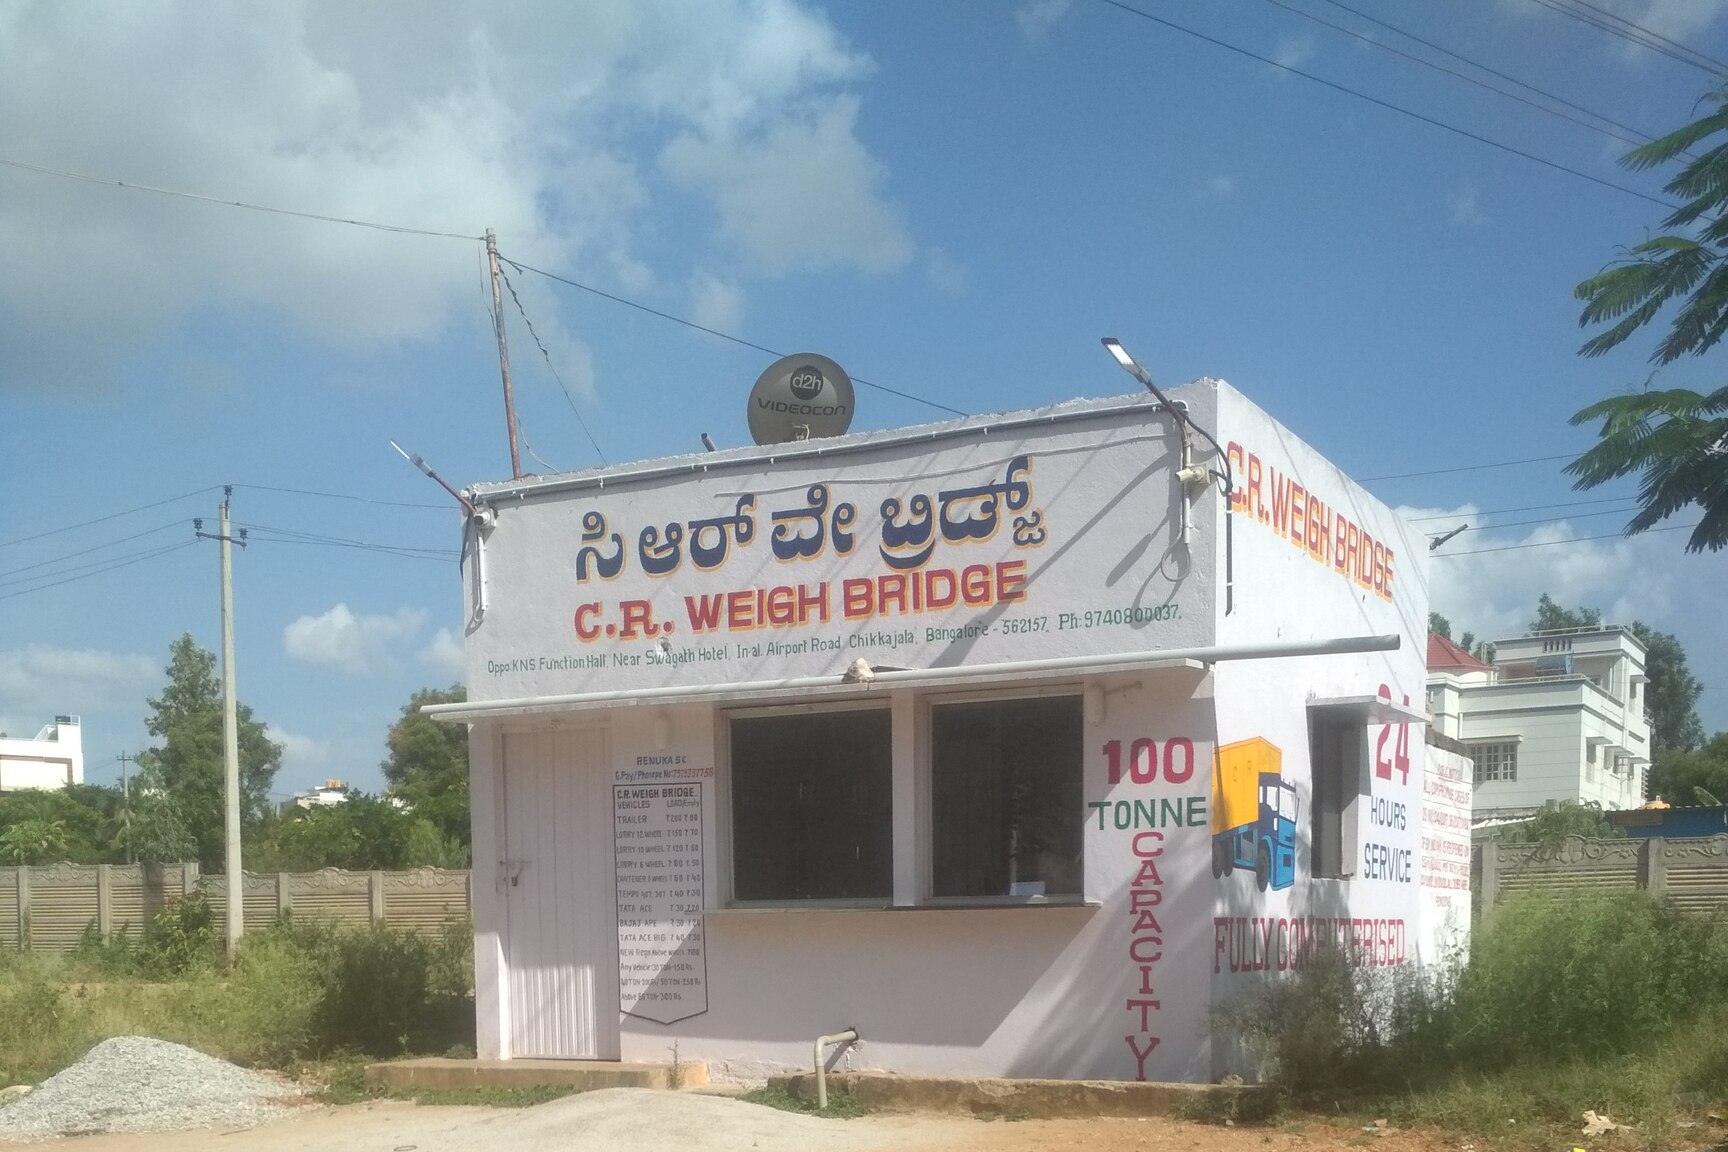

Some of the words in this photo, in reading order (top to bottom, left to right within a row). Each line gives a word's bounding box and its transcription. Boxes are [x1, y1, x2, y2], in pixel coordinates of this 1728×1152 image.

[792, 373, 822, 391] d2h
[1270, 466, 1332, 568] WEIGH
[1335, 512, 1394, 604] BRIDGE
[574, 599, 675, 642] C.R.
[684, 582, 830, 633] WEIGH
[843, 560, 1027, 620] BRIDGE
[539, 655, 586, 670] Function
[613, 652, 641, 667] Near
[766, 640, 808, 659] Airport
[811, 635, 841, 652] Road
[925, 622, 989, 644] Bangalore
[1375, 683, 1410, 786] 24
[636, 756, 673, 766] RENUKA
[1102, 736, 1195, 785] 100
[617, 800, 651, 810] VEHICLES
[662, 787, 695, 798] BRIDGE
[1088, 796, 1208, 831] TONNE
[1370, 795, 1407, 831] HOURS
[617, 815, 648, 824] TRAILER
[1363, 842, 1412, 884] SERVICE
[1124, 831, 1164, 1082] CAPACITY
[1213, 916, 1275, 975] FULLY
